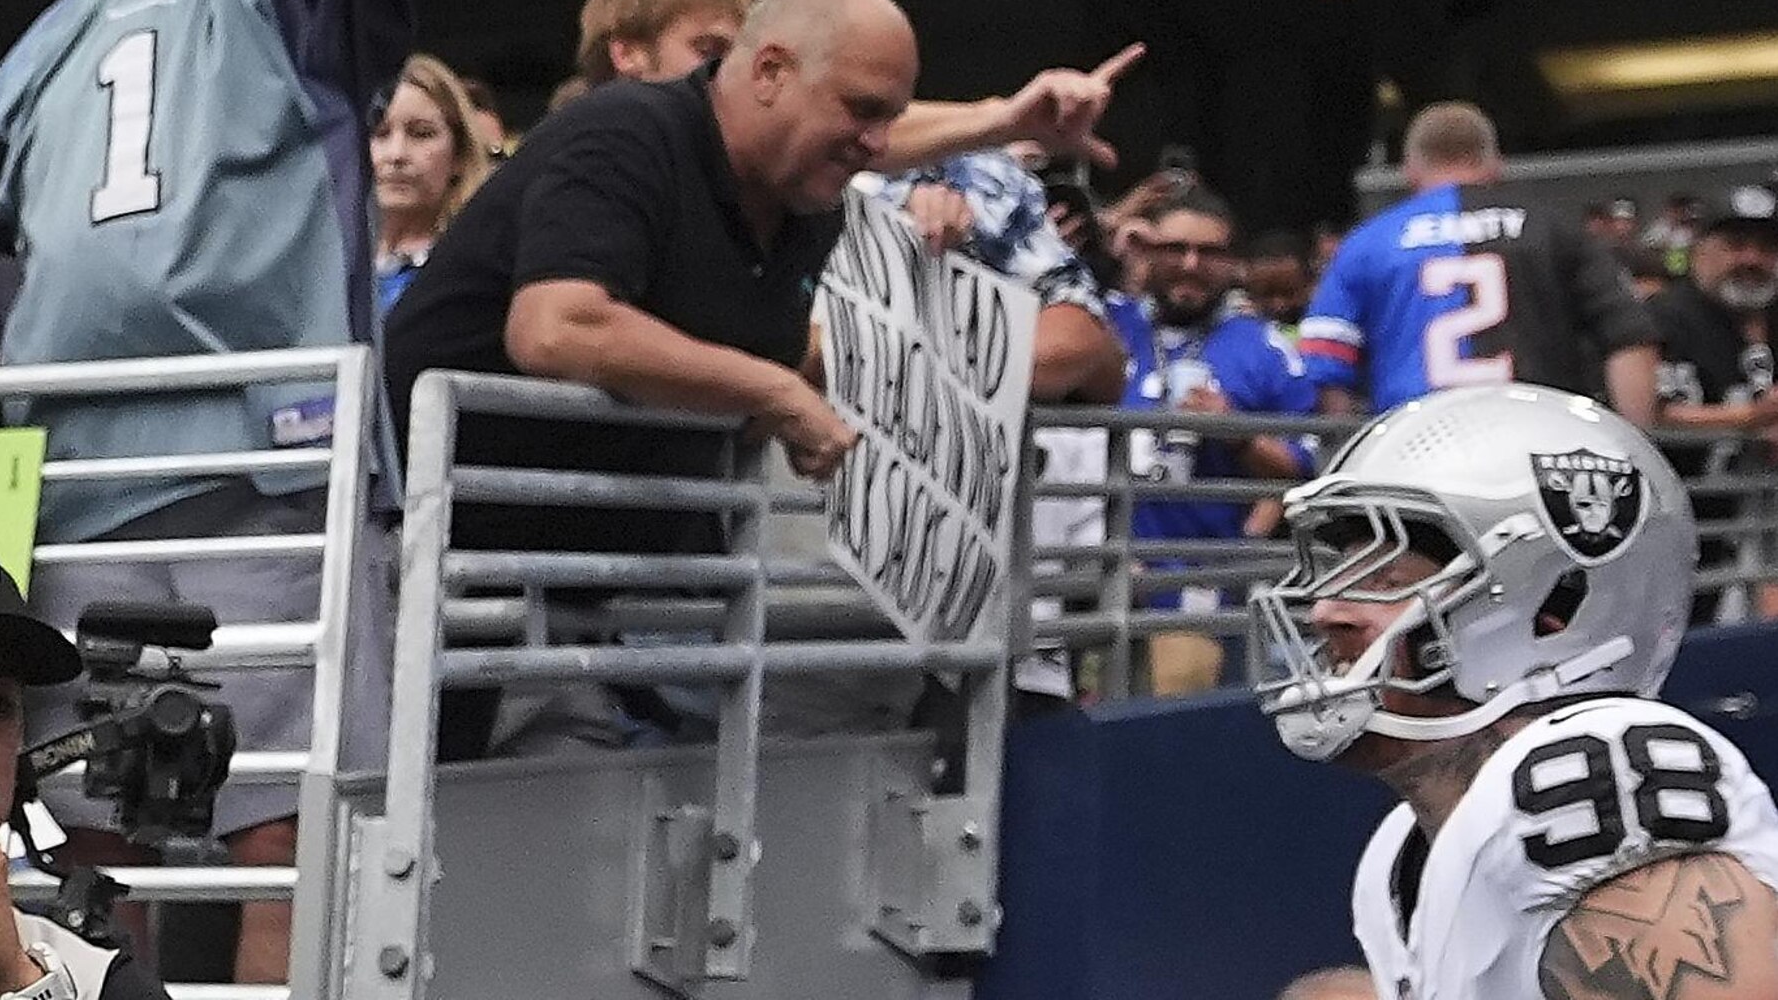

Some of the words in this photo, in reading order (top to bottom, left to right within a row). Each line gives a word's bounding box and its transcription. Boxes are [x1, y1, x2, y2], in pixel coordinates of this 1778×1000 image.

[89, 29, 160, 226] 1
[1422, 252, 1514, 388] 2
[1512, 722, 1730, 869] 98
